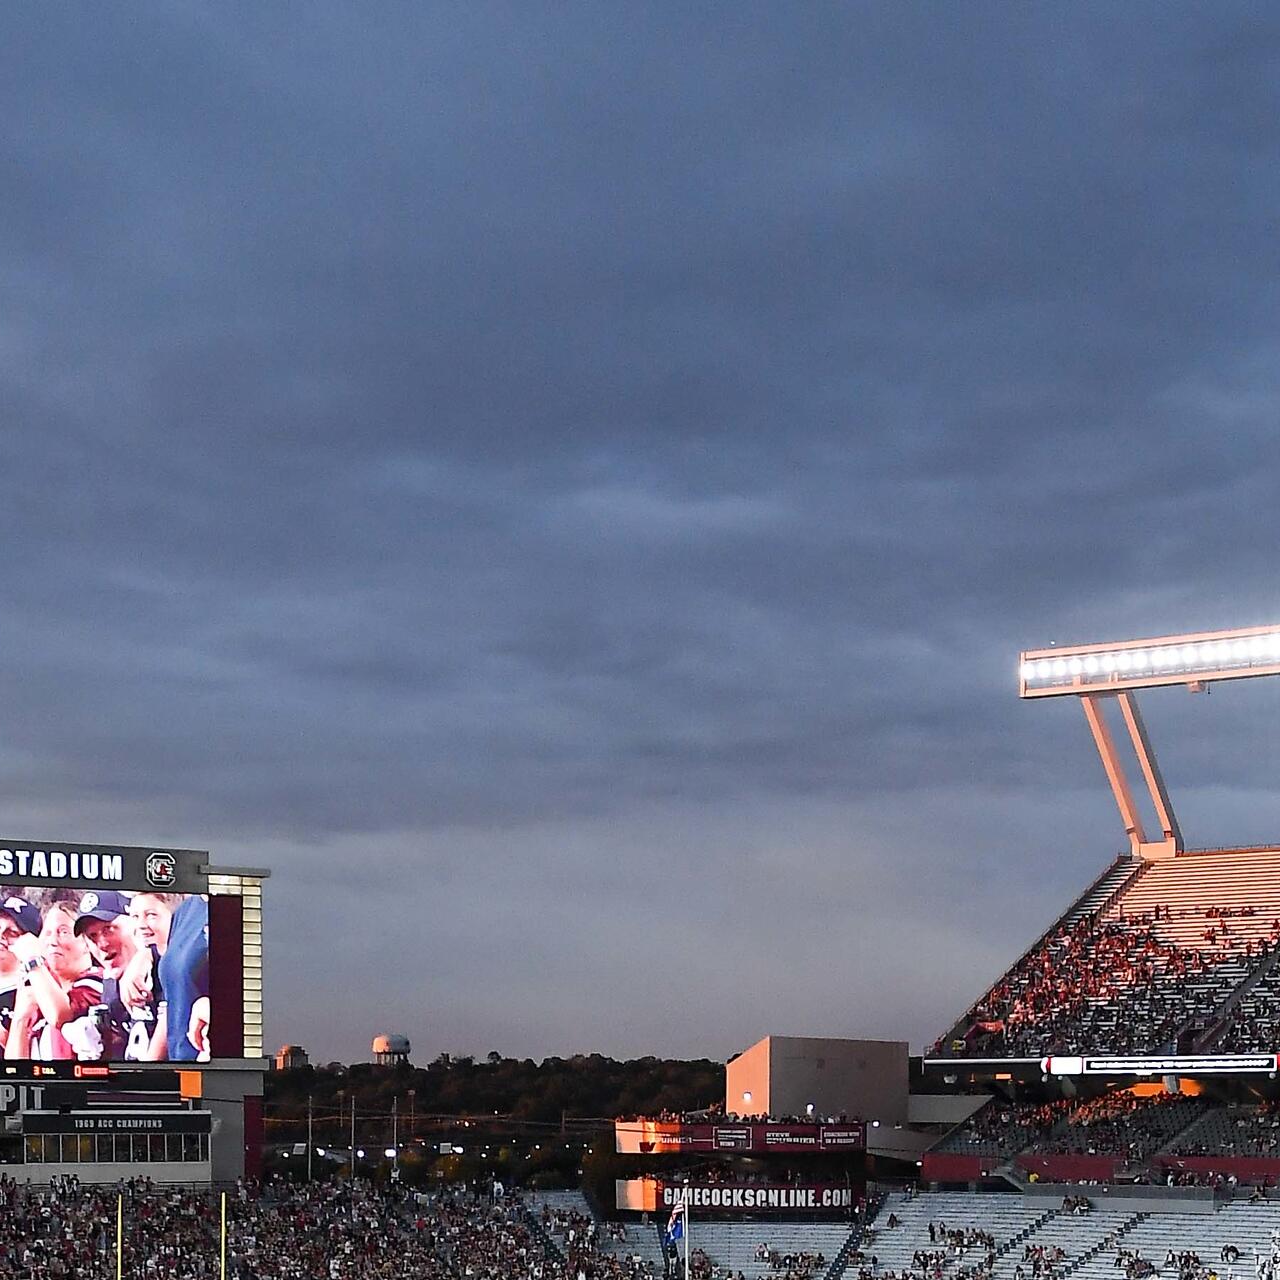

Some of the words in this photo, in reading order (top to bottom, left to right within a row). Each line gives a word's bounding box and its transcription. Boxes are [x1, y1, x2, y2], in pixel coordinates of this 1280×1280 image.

[74, 1119, 94, 1128] 1969
[98, 1119, 113, 1128] ACC
[117, 1119, 163, 1129] CHAMPIONS
[663, 1187, 852, 1208] GAMECOCKSONLINE.COM
